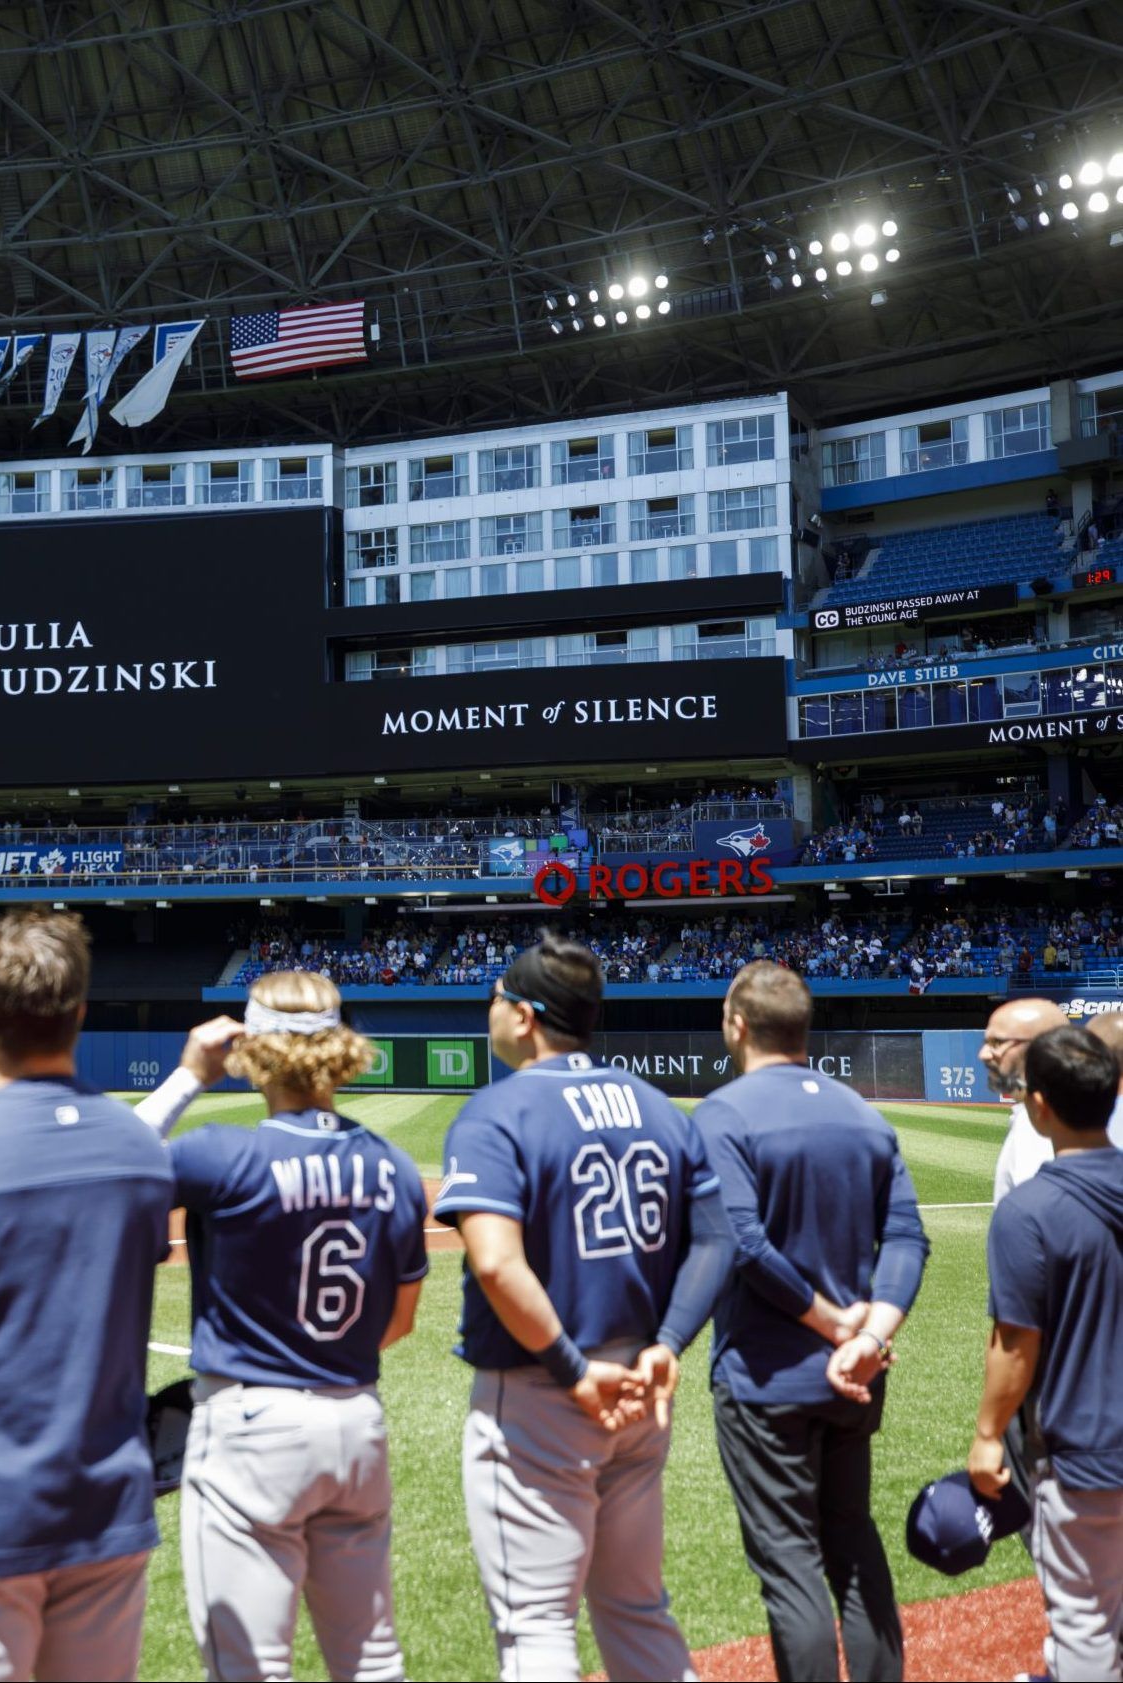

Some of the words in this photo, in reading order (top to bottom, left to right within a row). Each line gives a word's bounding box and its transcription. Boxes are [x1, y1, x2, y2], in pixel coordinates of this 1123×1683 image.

[1086, 569, 1111, 584] 1:29
[845, 602, 895, 616] BUDZINSKI
[896, 596, 933, 610] PASSED
[935, 592, 965, 605] AWAY
[966, 590, 980, 600] AT
[816, 612, 838, 627] CC
[845, 616, 863, 627] THE
[865, 612, 897, 625] YOUNG
[899, 609, 918, 620] AGE
[868, 670, 907, 686] DAVE
[915, 665, 959, 681] STIEB
[381, 703, 530, 736] MOMENT
[542, 700, 565, 725] of
[574, 695, 718, 725] SILENCE
[988, 718, 1088, 744] MOMENT
[1096, 714, 1112, 731] of
[72, 850, 122, 864] FLIGHT
[588, 856, 776, 901] ROGERS
[1059, 998, 1123, 1016] eScor
[127, 1060, 160, 1077] 400
[364, 1049, 389, 1075] D
[431, 1049, 470, 1076] TD
[610, 1055, 703, 1075] OMENT
[713, 1054, 731, 1075] of
[940, 1066, 975, 1085] 375
[945, 1086, 972, 1098] 114.3
[562, 1082, 643, 1132] CHOI
[270, 1153, 396, 1213] WALLS
[570, 1140, 670, 1260] 26
[297, 1219, 367, 1342] 6
